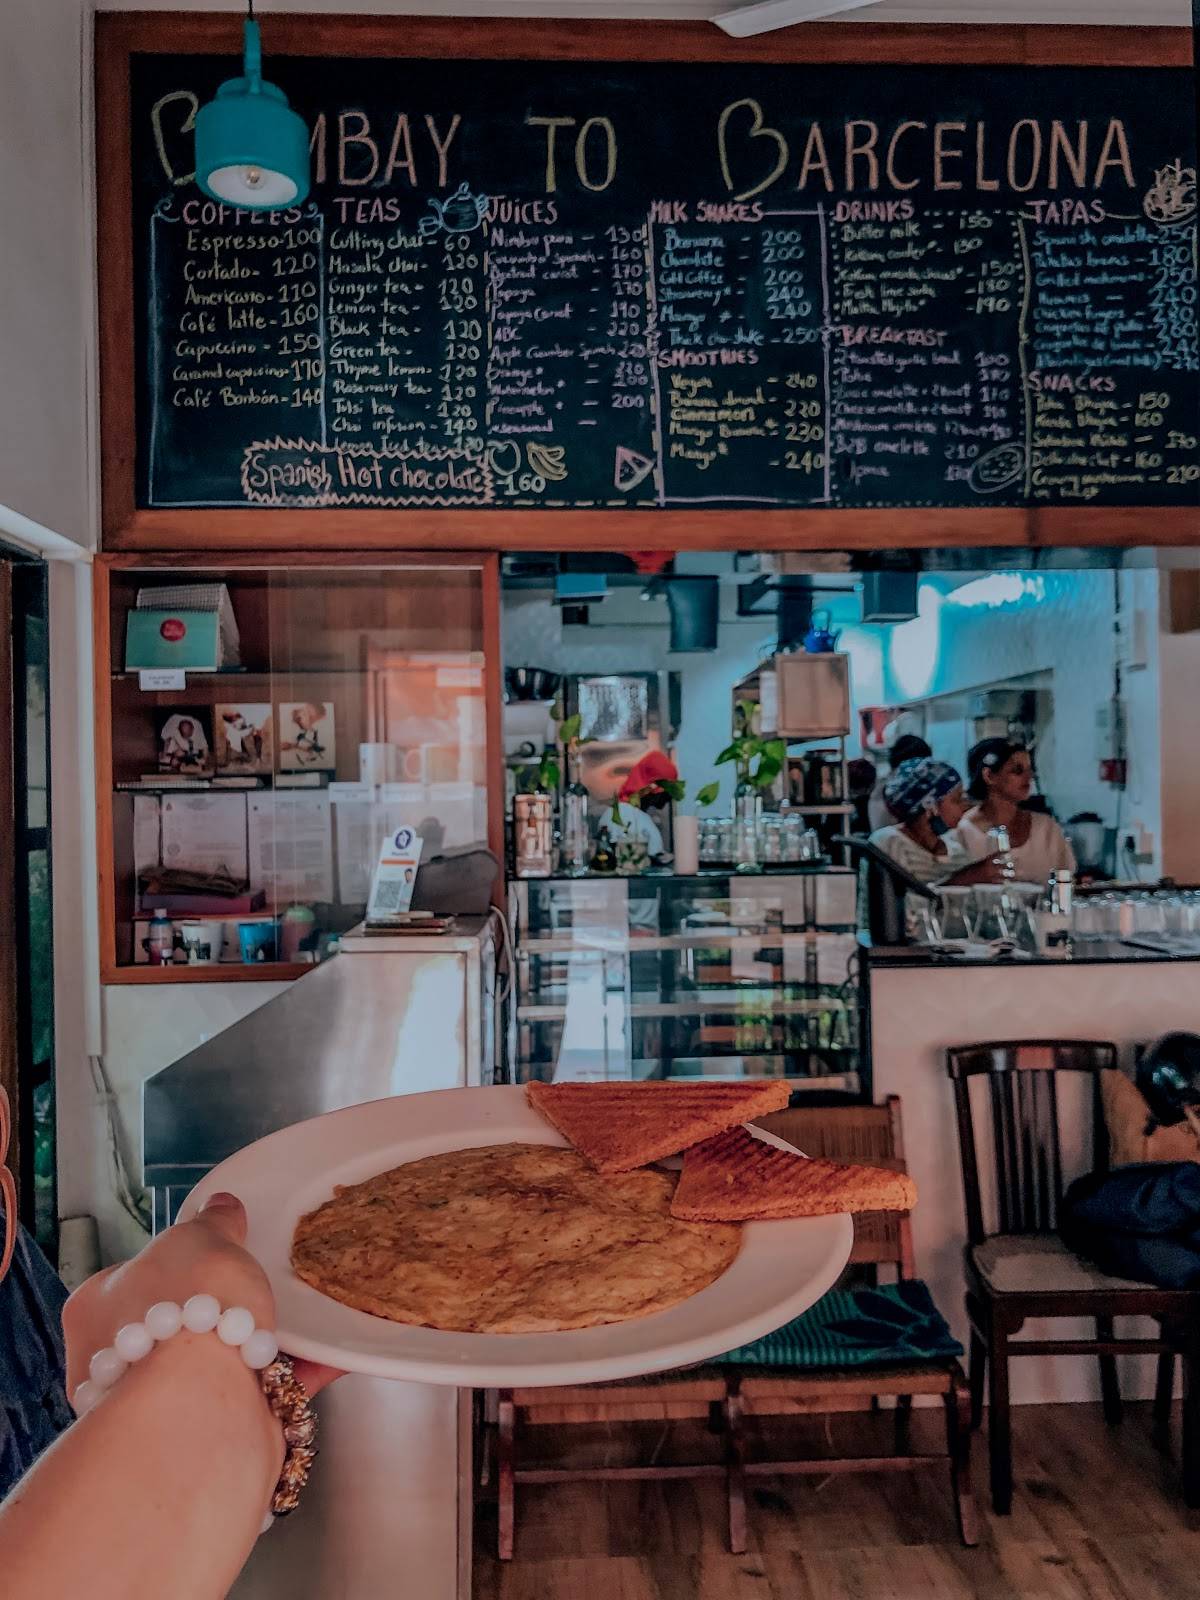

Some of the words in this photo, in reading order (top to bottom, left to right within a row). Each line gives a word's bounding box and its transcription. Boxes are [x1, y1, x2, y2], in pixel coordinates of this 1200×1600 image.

[151, 90, 461, 187] BBAY
[528, 115, 617, 193] TO
[718, 98, 1136, 200] BARCELONA
[333, 198, 400, 224] TEAS
[834, 199, 915, 222] DRINKS
[1026, 199, 1106, 225] TAPAS
[188, 229, 280, 257] Espresso
[284, 228, 321, 249] 100
[444, 233, 471, 251] 60
[604, 225, 642, 243] 130
[762, 230, 801, 247] 200
[329, 252, 383, 274] Masala
[442, 253, 479, 271] 120
[611, 245, 642, 261] 160
[762, 247, 804, 264] 200
[184, 257, 252, 281] Cortado
[272, 252, 317, 276] 120
[611, 263, 643, 279] 170
[764, 268, 803, 286] 200
[185, 284, 265, 305] Americano
[279, 281, 317, 303] 110
[329, 276, 378, 303] Ginger
[383, 276, 412, 295] tea
[438, 277, 474, 295] 120
[612, 281, 643, 296] 170
[766, 285, 804, 303] 240
[329, 296, 376, 314] Lemon
[381, 296, 410, 315] tea
[766, 301, 812, 320] 240
[180, 312, 216, 334] Café
[228, 306, 267, 330] latte
[281, 303, 319, 328] 160
[327, 315, 370, 338] Black
[379, 315, 410, 336] tea
[443, 319, 482, 341] 120
[278, 333, 320, 355] 150
[494, 327, 522, 342] ABC
[330, 340, 374, 358] Green
[376, 336, 400, 357] tea
[445, 343, 480, 360] 120
[291, 359, 323, 381] 170
[330, 359, 382, 381] Thyme
[333, 379, 398, 398] Rosemary
[1028, 370, 1117, 393] SNACKS
[173, 388, 212, 407] Café
[611, 394, 645, 408] 200
[251, 453, 331, 497] Spanish
[338, 453, 383, 489] Hot
[390, 458, 484, 491] chocolate
